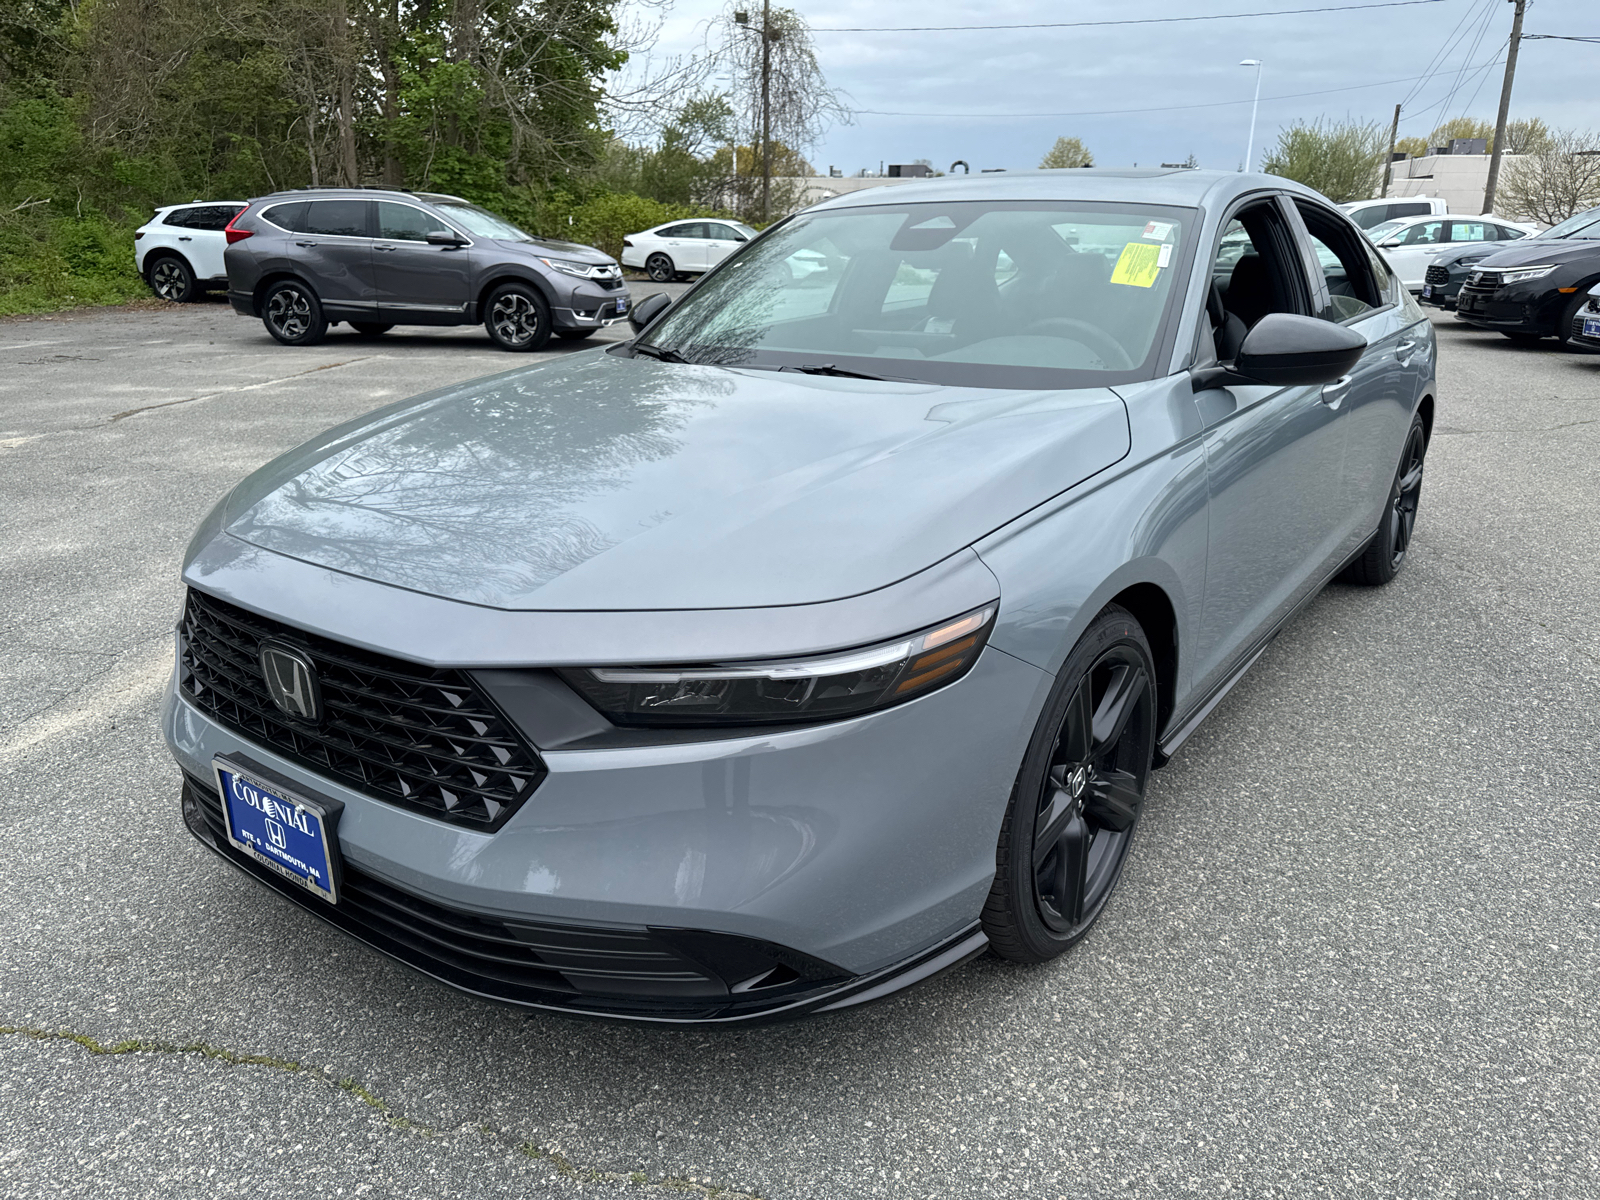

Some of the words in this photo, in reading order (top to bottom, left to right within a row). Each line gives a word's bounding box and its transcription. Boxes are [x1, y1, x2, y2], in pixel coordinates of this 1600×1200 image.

[232, 780, 315, 837] COLONIAL
[241, 829, 256, 843] RTE.
[265, 842, 309, 873] DARTMOUTH,
[309, 866, 321, 879] MA
[253, 851, 285, 875] COLONIAL
[285, 870, 309, 889] HONDA
